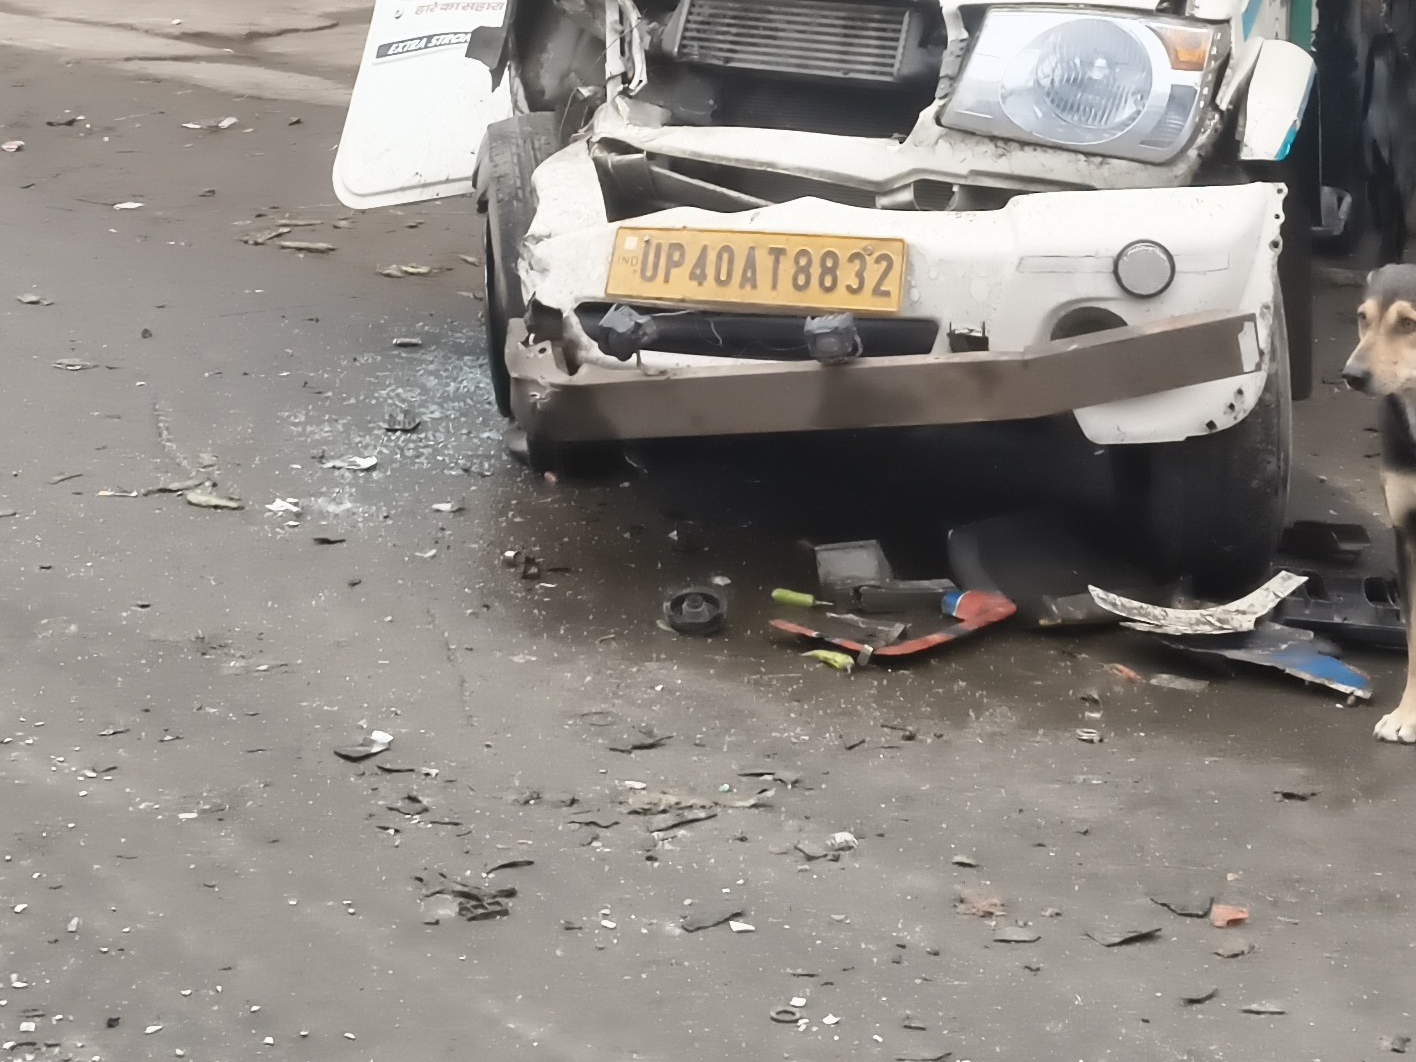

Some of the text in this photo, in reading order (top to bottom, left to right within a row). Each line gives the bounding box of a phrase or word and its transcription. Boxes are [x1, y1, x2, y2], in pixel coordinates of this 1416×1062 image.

[387, 33, 472, 54] EXTRA STRON
[617, 241, 895, 298] IND UP40AT8832
